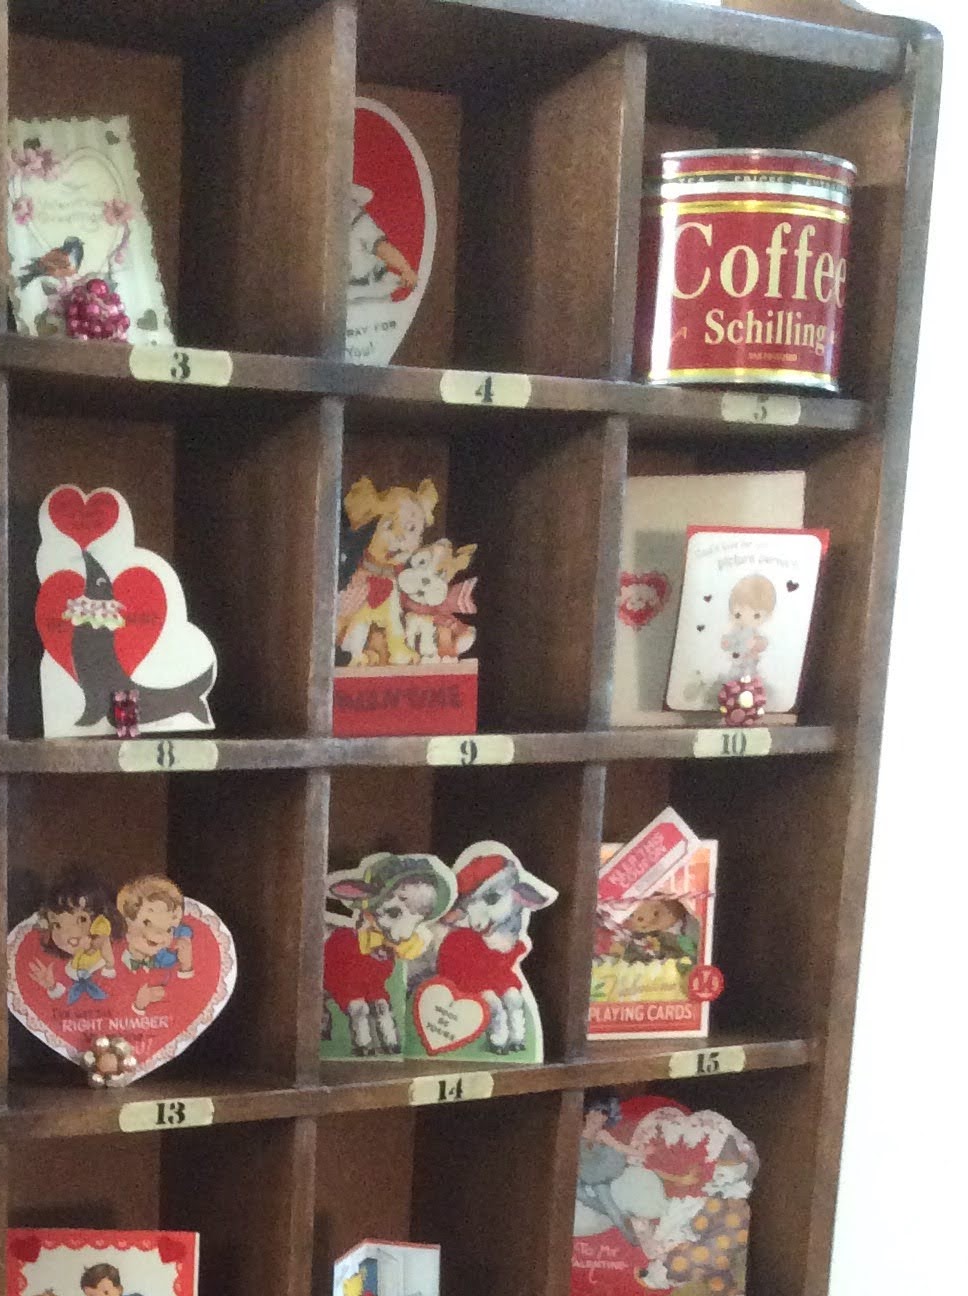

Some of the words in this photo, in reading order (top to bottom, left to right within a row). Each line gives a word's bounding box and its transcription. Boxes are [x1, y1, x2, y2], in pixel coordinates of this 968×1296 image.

[673, 221, 847, 308] Coffee
[704, 308, 826, 355] Schilling
[171, 352, 190, 379] 3
[475, 376, 494, 402] 4
[754, 395, 768, 420] 5
[157, 741, 175, 767] 8
[460, 739, 478, 766] 9
[721, 733, 747, 754] 10
[62, 1017, 103, 1033] RIGHT
[108, 1015, 169, 1030] NUMBER
[590, 1003, 644, 1022] PLAYING
[646, 1003, 692, 1021] CARDS
[696, 1052, 720, 1074] 15
[438, 1078, 463, 1101] 14
[155, 1102, 186, 1125] 13
